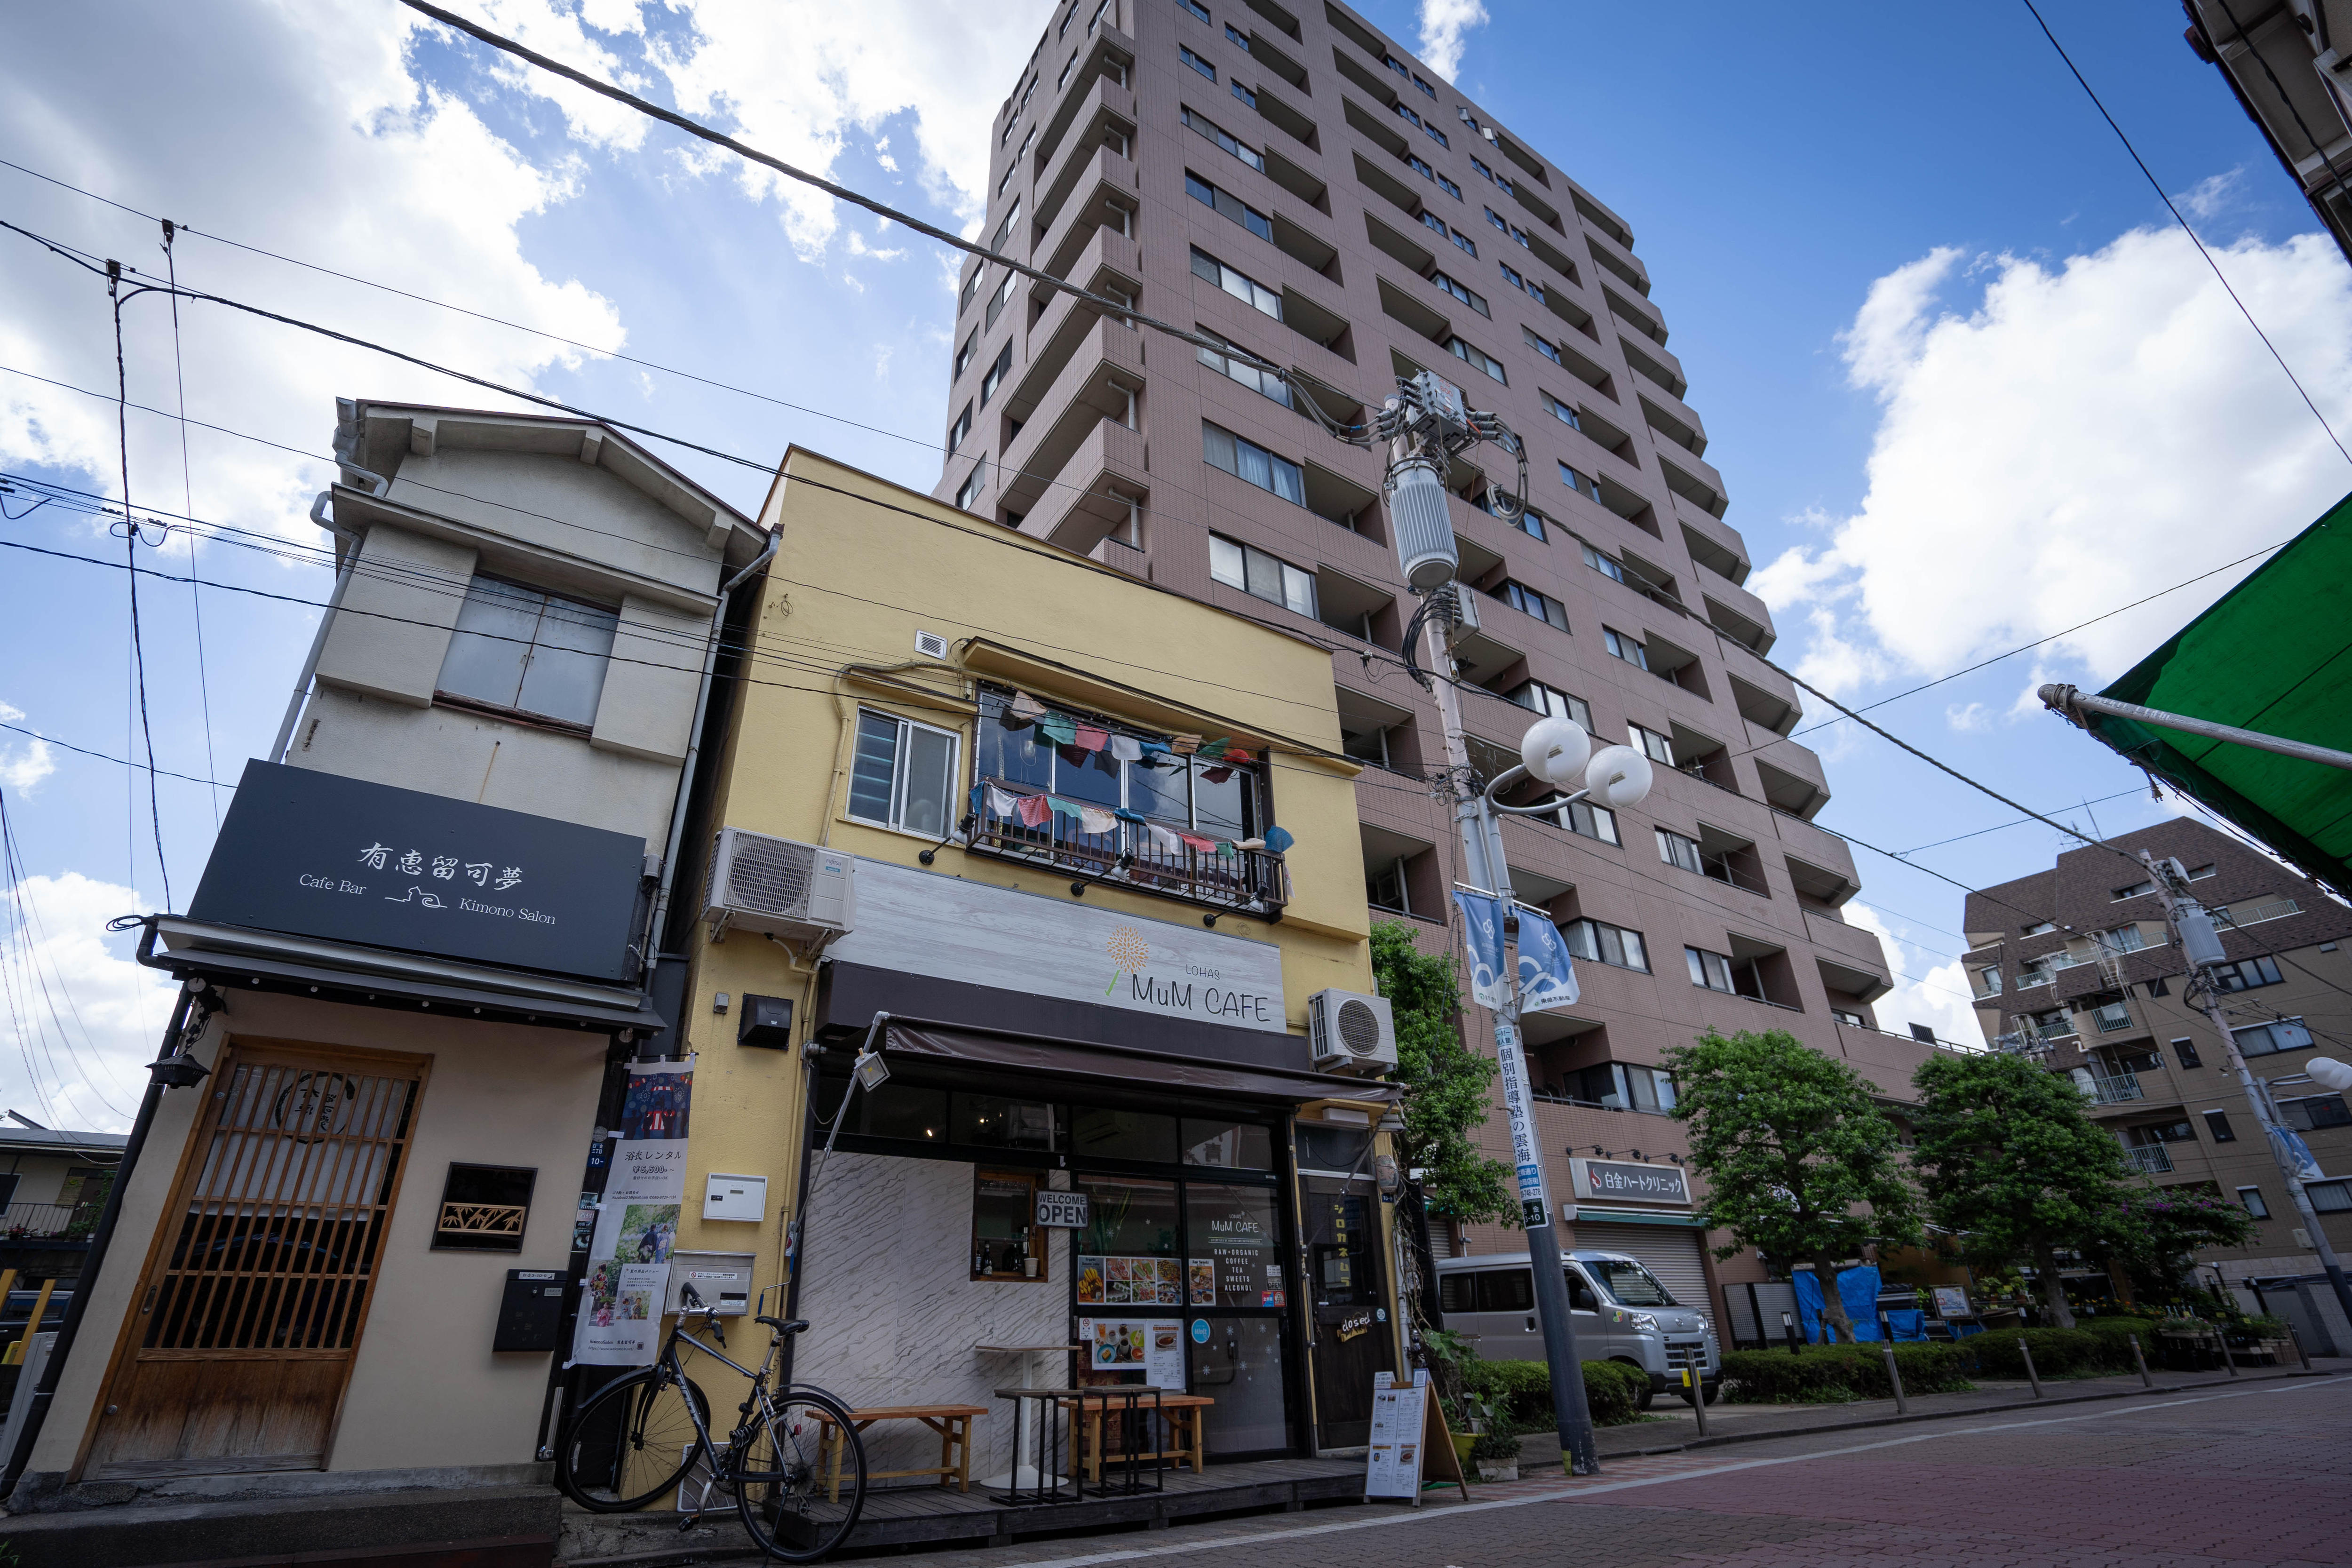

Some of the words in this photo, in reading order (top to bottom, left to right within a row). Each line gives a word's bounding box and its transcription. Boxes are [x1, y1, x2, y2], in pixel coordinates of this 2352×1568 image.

[300, 874, 334, 890] Cafe
[338, 880, 366, 895] Bar
[459, 898, 514, 917] Kimono
[518, 908, 556, 925] Salon
[1186, 964, 1220, 980] LOHAS
[1133, 974, 1192, 1011] MuM
[1205, 987, 1271, 1022] CAFE
[1541, 995, 1571, 1004] 東急不動産
[1501, 1048, 1532, 1163] 個別指導塾の雲海
[625, 1150, 682, 1161] 浴衣レンタル
[1605, 1171, 1682, 1193] 白金ハートクリニック
[1039, 1194, 1085, 1205] WELCOME
[1038, 1204, 1087, 1224] OPEN
[1212, 1220, 1232, 1232] MuM
[1236, 1221, 1259, 1233] CAFE
[1334, 1204, 1350, 1287] シロカネムラ
[1343, 1312, 1370, 1332] closed
